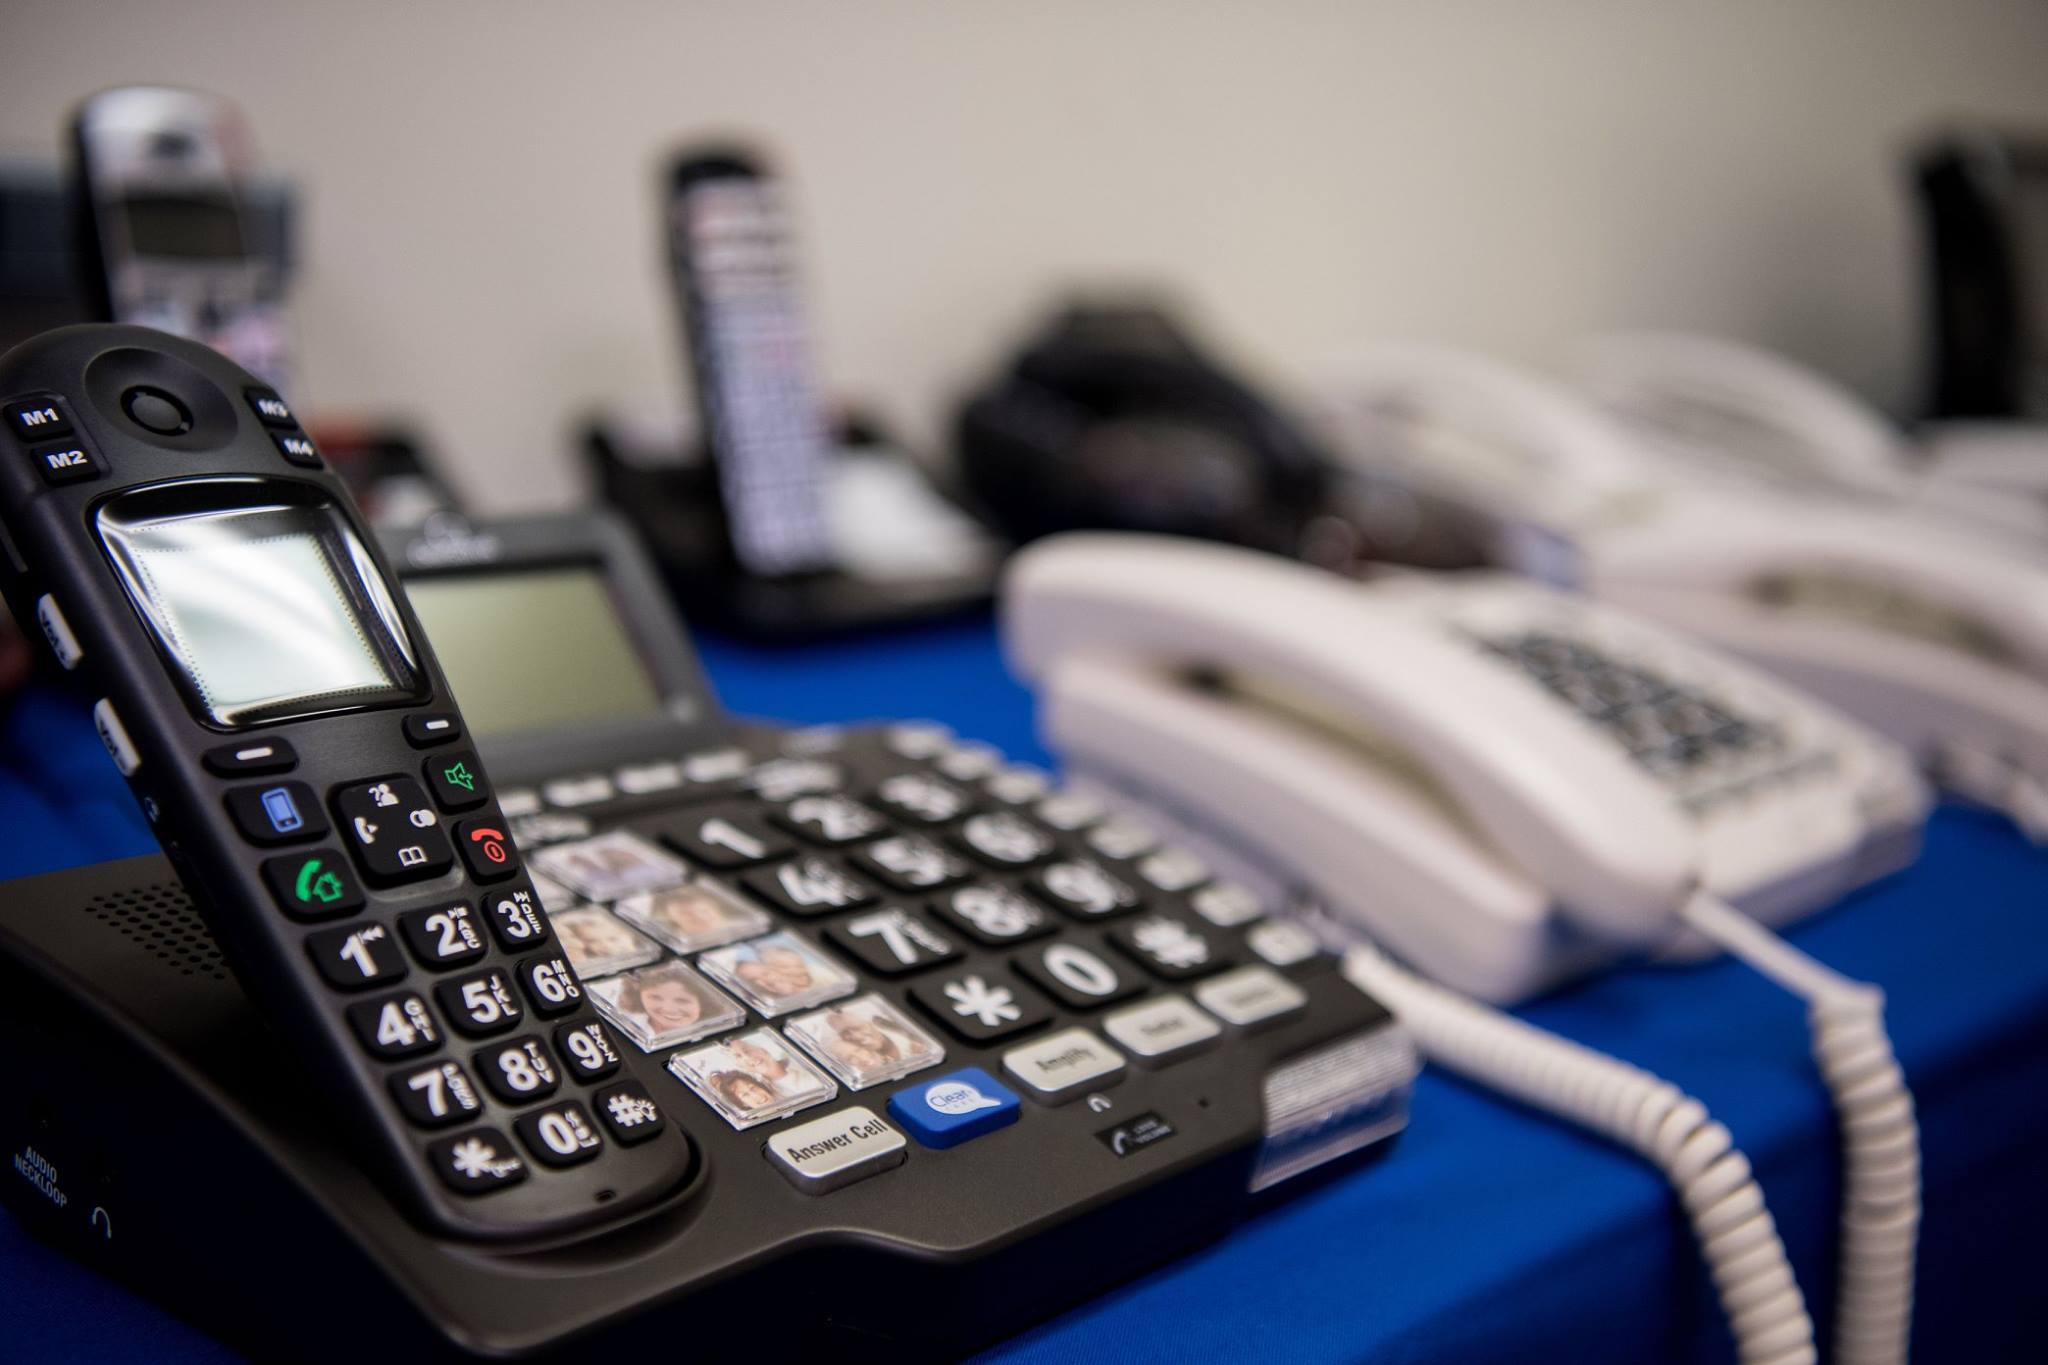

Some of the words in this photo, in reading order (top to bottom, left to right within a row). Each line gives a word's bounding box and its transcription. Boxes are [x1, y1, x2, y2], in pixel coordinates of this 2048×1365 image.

[21, 408, 59, 426] M1
[259, 399, 288, 418] M3
[47, 450, 88, 469] M2
[284, 438, 314, 457] M4
[700, 819, 765, 859] 1
[425, 914, 468, 957] 2
[497, 900, 531, 938] 3
[849, 913, 918, 964] 7
[340, 932, 378, 977] 1
[1043, 943, 1118, 995] 0
[462, 980, 501, 1023] 5
[490, 973, 519, 1017] JKL
[533, 964, 566, 1002] 6
[551, 960, 579, 998] MNO
[377, 1001, 416, 1046] 4
[499, 1049, 540, 1091] 8
[523, 1041, 555, 1084] TUV
[568, 1030, 604, 1070] 9
[408, 1068, 448, 1117] 7
[929, 1088, 969, 1109] Clear
[538, 1113, 579, 1155] 0
[787, 1132, 853, 1163] Answer
[850, 1118, 889, 1141] Cell
[15, 1153, 67, 1207] NECKLOOP
[25, 1146, 57, 1184] AUDIO
